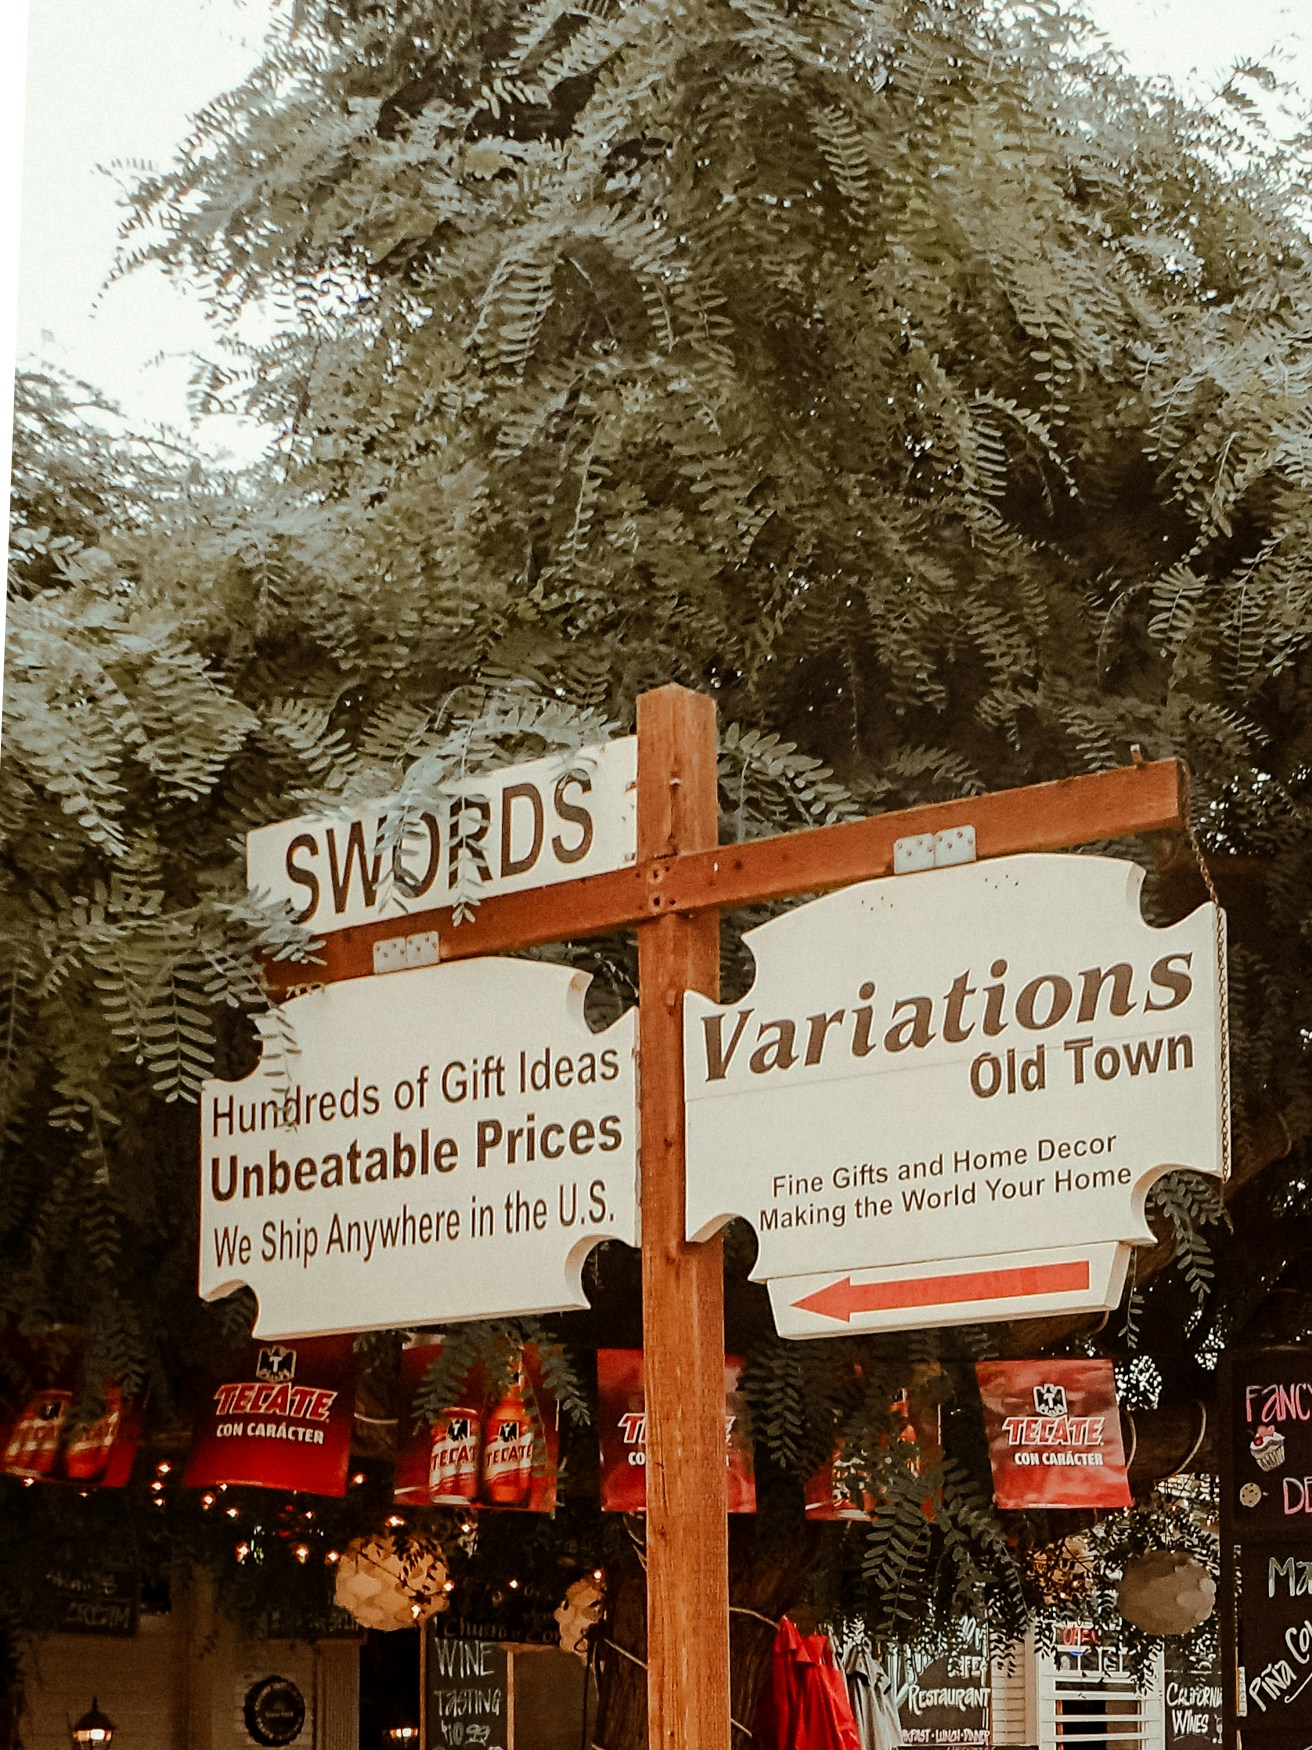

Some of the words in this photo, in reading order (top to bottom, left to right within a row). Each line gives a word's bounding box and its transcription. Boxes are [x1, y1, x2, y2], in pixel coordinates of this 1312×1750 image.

[285, 768, 594, 922] SWORDS
[700, 951, 1194, 1083] Variations
[212, 1072, 380, 1137] Hundreds
[394, 1066, 429, 1110] of
[441, 1056, 505, 1105] Gift
[518, 1046, 620, 1093] Ideas
[969, 1048, 1045, 1098] Old
[1064, 1031, 1194, 1086] Town
[210, 1130, 459, 1202] Unbeatable
[475, 1113, 623, 1168] Prices
[772, 1173, 823, 1199] Fine
[832, 1164, 888, 1191] Gifts
[897, 1152, 944, 1180] and
[952, 1144, 1028, 1174] Home
[1037, 1132, 1118, 1163] Decor
[213, 1226, 252, 1268] We
[261, 1216, 317, 1268] Ship
[326, 1203, 460, 1264] Anywhere
[470, 1195, 495, 1237] in
[504, 1188, 548, 1233] the
[558, 1179, 616, 1227] U.S.
[759, 1204, 847, 1232] Making
[854, 1195, 893, 1220] the
[900, 1182, 976, 1212] World
[984, 1176, 1045, 1203] Your
[1054, 1164, 1132, 1194] Home
[213, 1382, 338, 1422] TECATE
[216, 1422, 244, 1438] CON
[246, 1420, 325, 1445] CARÁCTER
[1002, 1415, 1105, 1445] TECATE
[432, 1446, 477, 1468] TECAT
[628, 1451, 646, 1466] CO
[1014, 1452, 1039, 1465] CON
[1042, 1449, 1104, 1465] CARÁCTER
[434, 1637, 495, 1679] WINE
